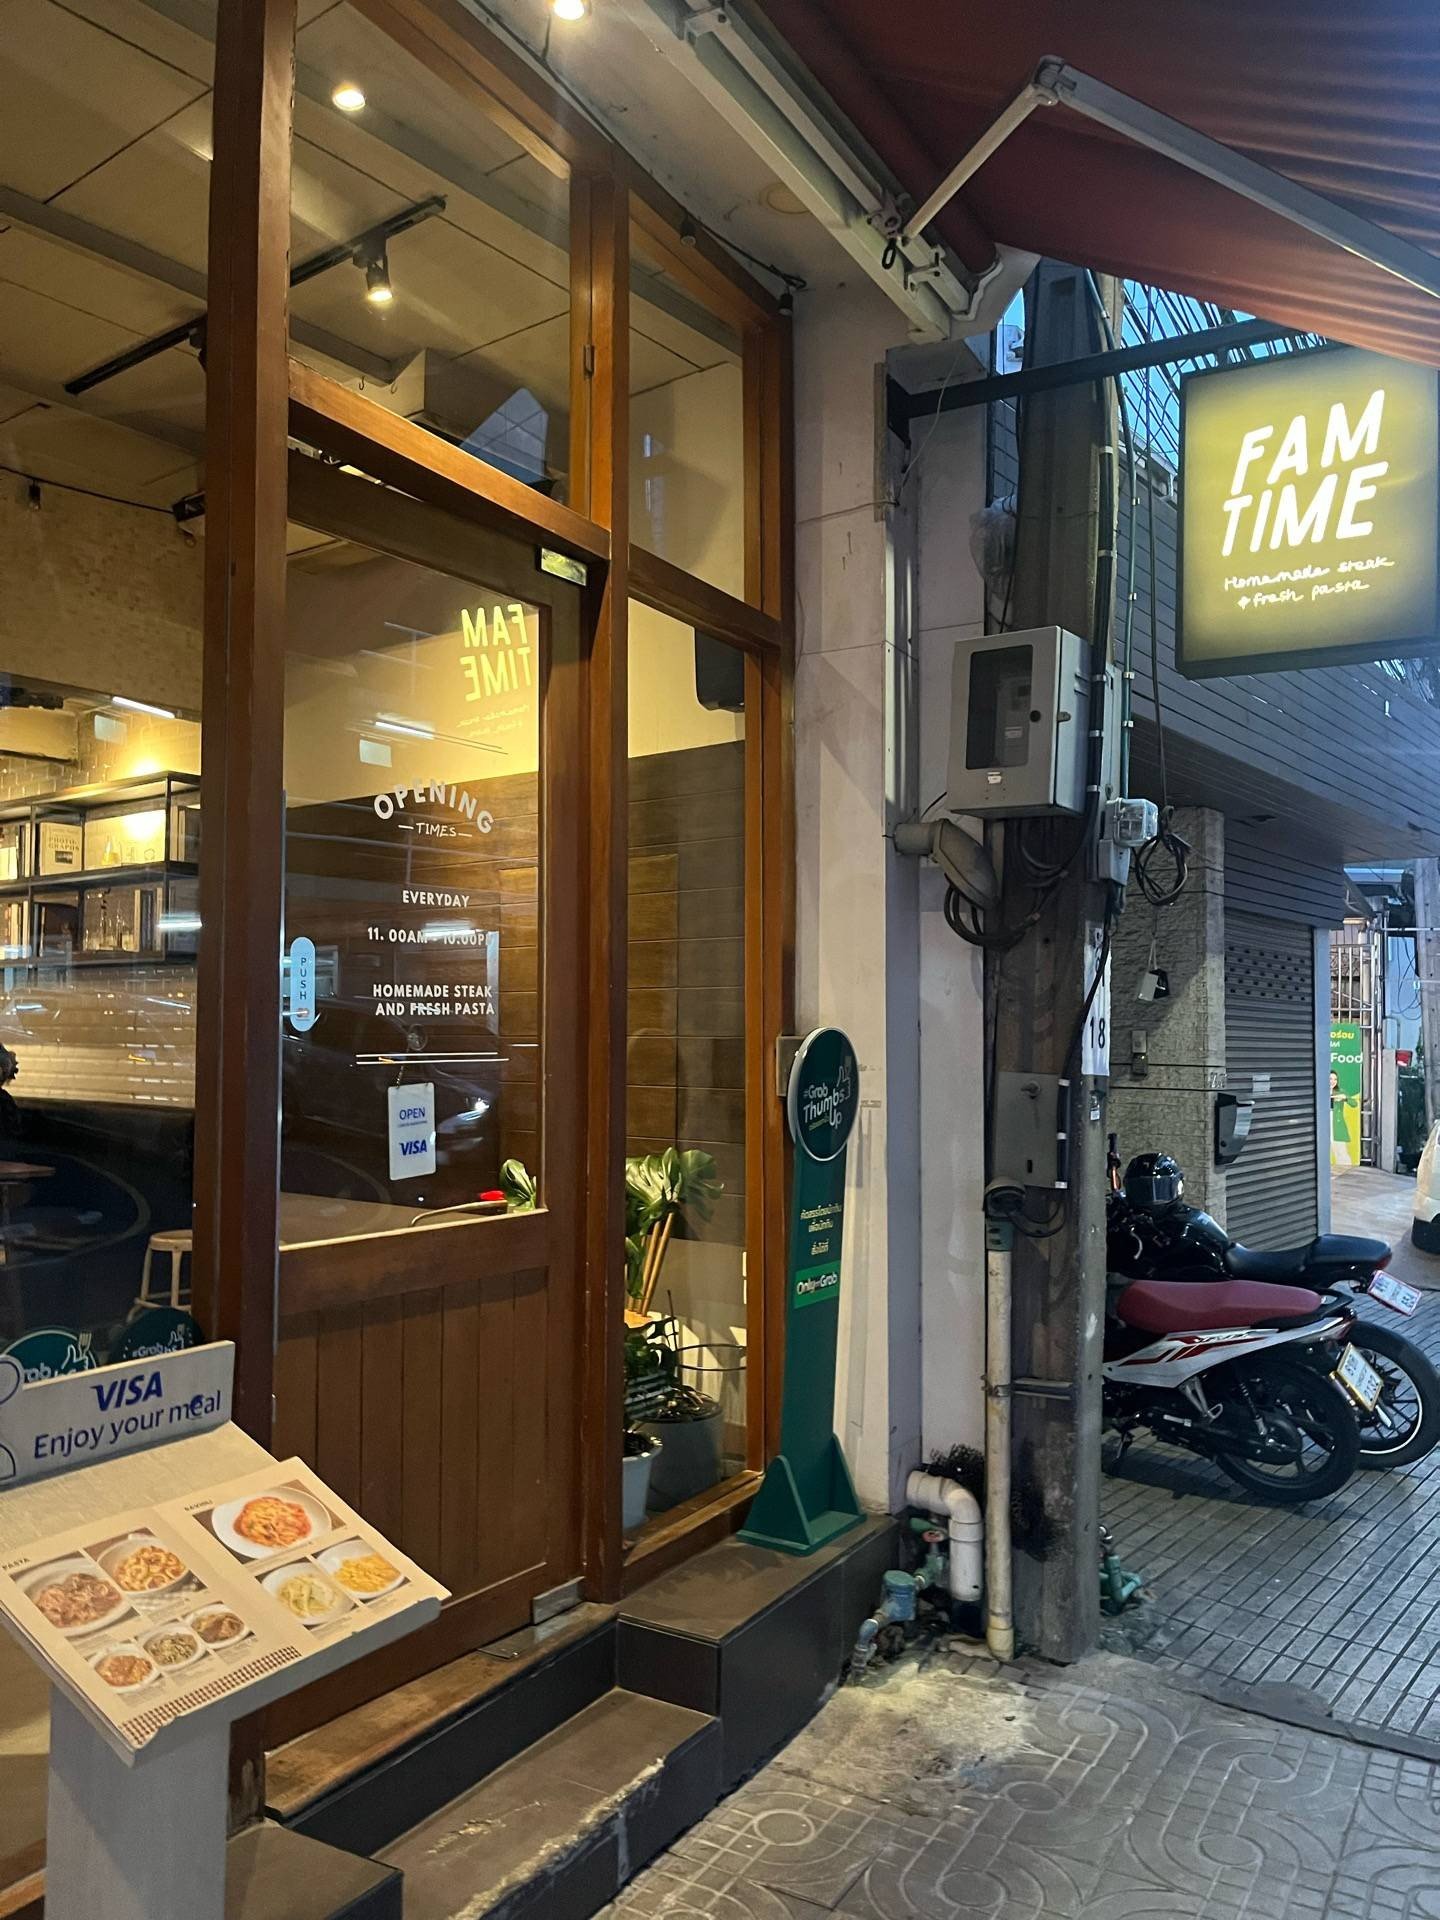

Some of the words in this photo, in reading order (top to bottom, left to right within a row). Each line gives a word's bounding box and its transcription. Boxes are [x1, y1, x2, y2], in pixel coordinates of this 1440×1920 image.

[1230, 389, 1385, 495] FAM
[1221, 461, 1389, 556] TIME
[1337, 556, 1395, 573] steak
[1253, 588, 1304, 607] fresh
[1311, 579, 1370, 601] pasta
[374, 778, 494, 834] OPENING
[416, 822, 457, 838] TIMES
[402, 889, 470, 908] EVERYDAY
[299, 957, 307, 1000] PUSH
[373, 984, 449, 998] HOMEMADE
[454, 985, 493, 998] STEAK
[375, 1003, 405, 1016] AND
[410, 1002, 450, 1016] FRESH
[455, 1003, 495, 1015] PASTA
[1089, 1017, 1106, 1049] 18
[399, 1107, 426, 1120] OPEN
[803, 1088, 845, 1123] Thumbs
[399, 1139, 428, 1156] VISA
[91, 1371, 163, 1412] VISA
[34, 1423, 105, 1459] Enjoy
[109, 1408, 164, 1444] your
[169, 1390, 221, 1423] meal
